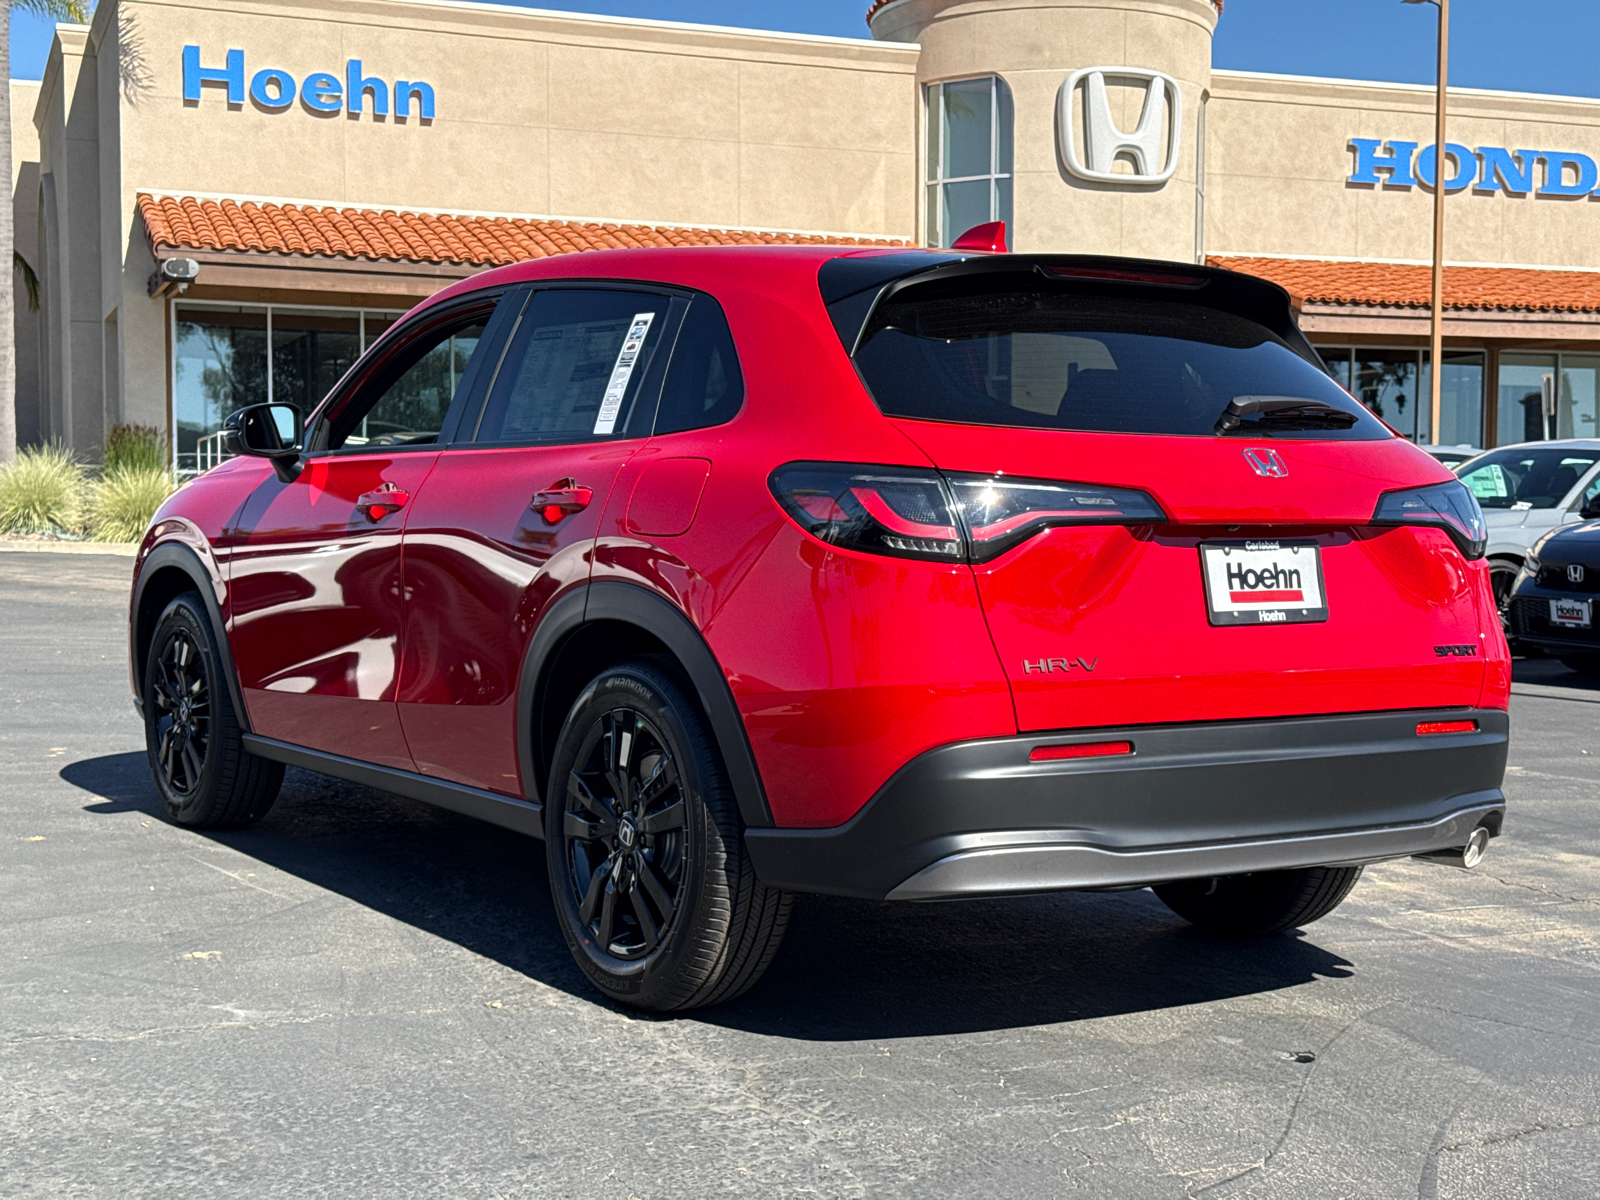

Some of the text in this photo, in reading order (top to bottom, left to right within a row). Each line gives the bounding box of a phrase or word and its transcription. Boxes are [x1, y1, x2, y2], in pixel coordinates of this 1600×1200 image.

[182, 45, 435, 119] Hoehn
[1347, 138, 1600, 197] HOND
[1245, 540, 1280, 551] Carlsbad
[1226, 562, 1302, 590] Hoehn
[1258, 610, 1286, 622] Hoehn
[1556, 604, 1583, 617] Hoehn
[1433, 645, 1477, 657] SPORT
[1022, 657, 1099, 674] HR-V
